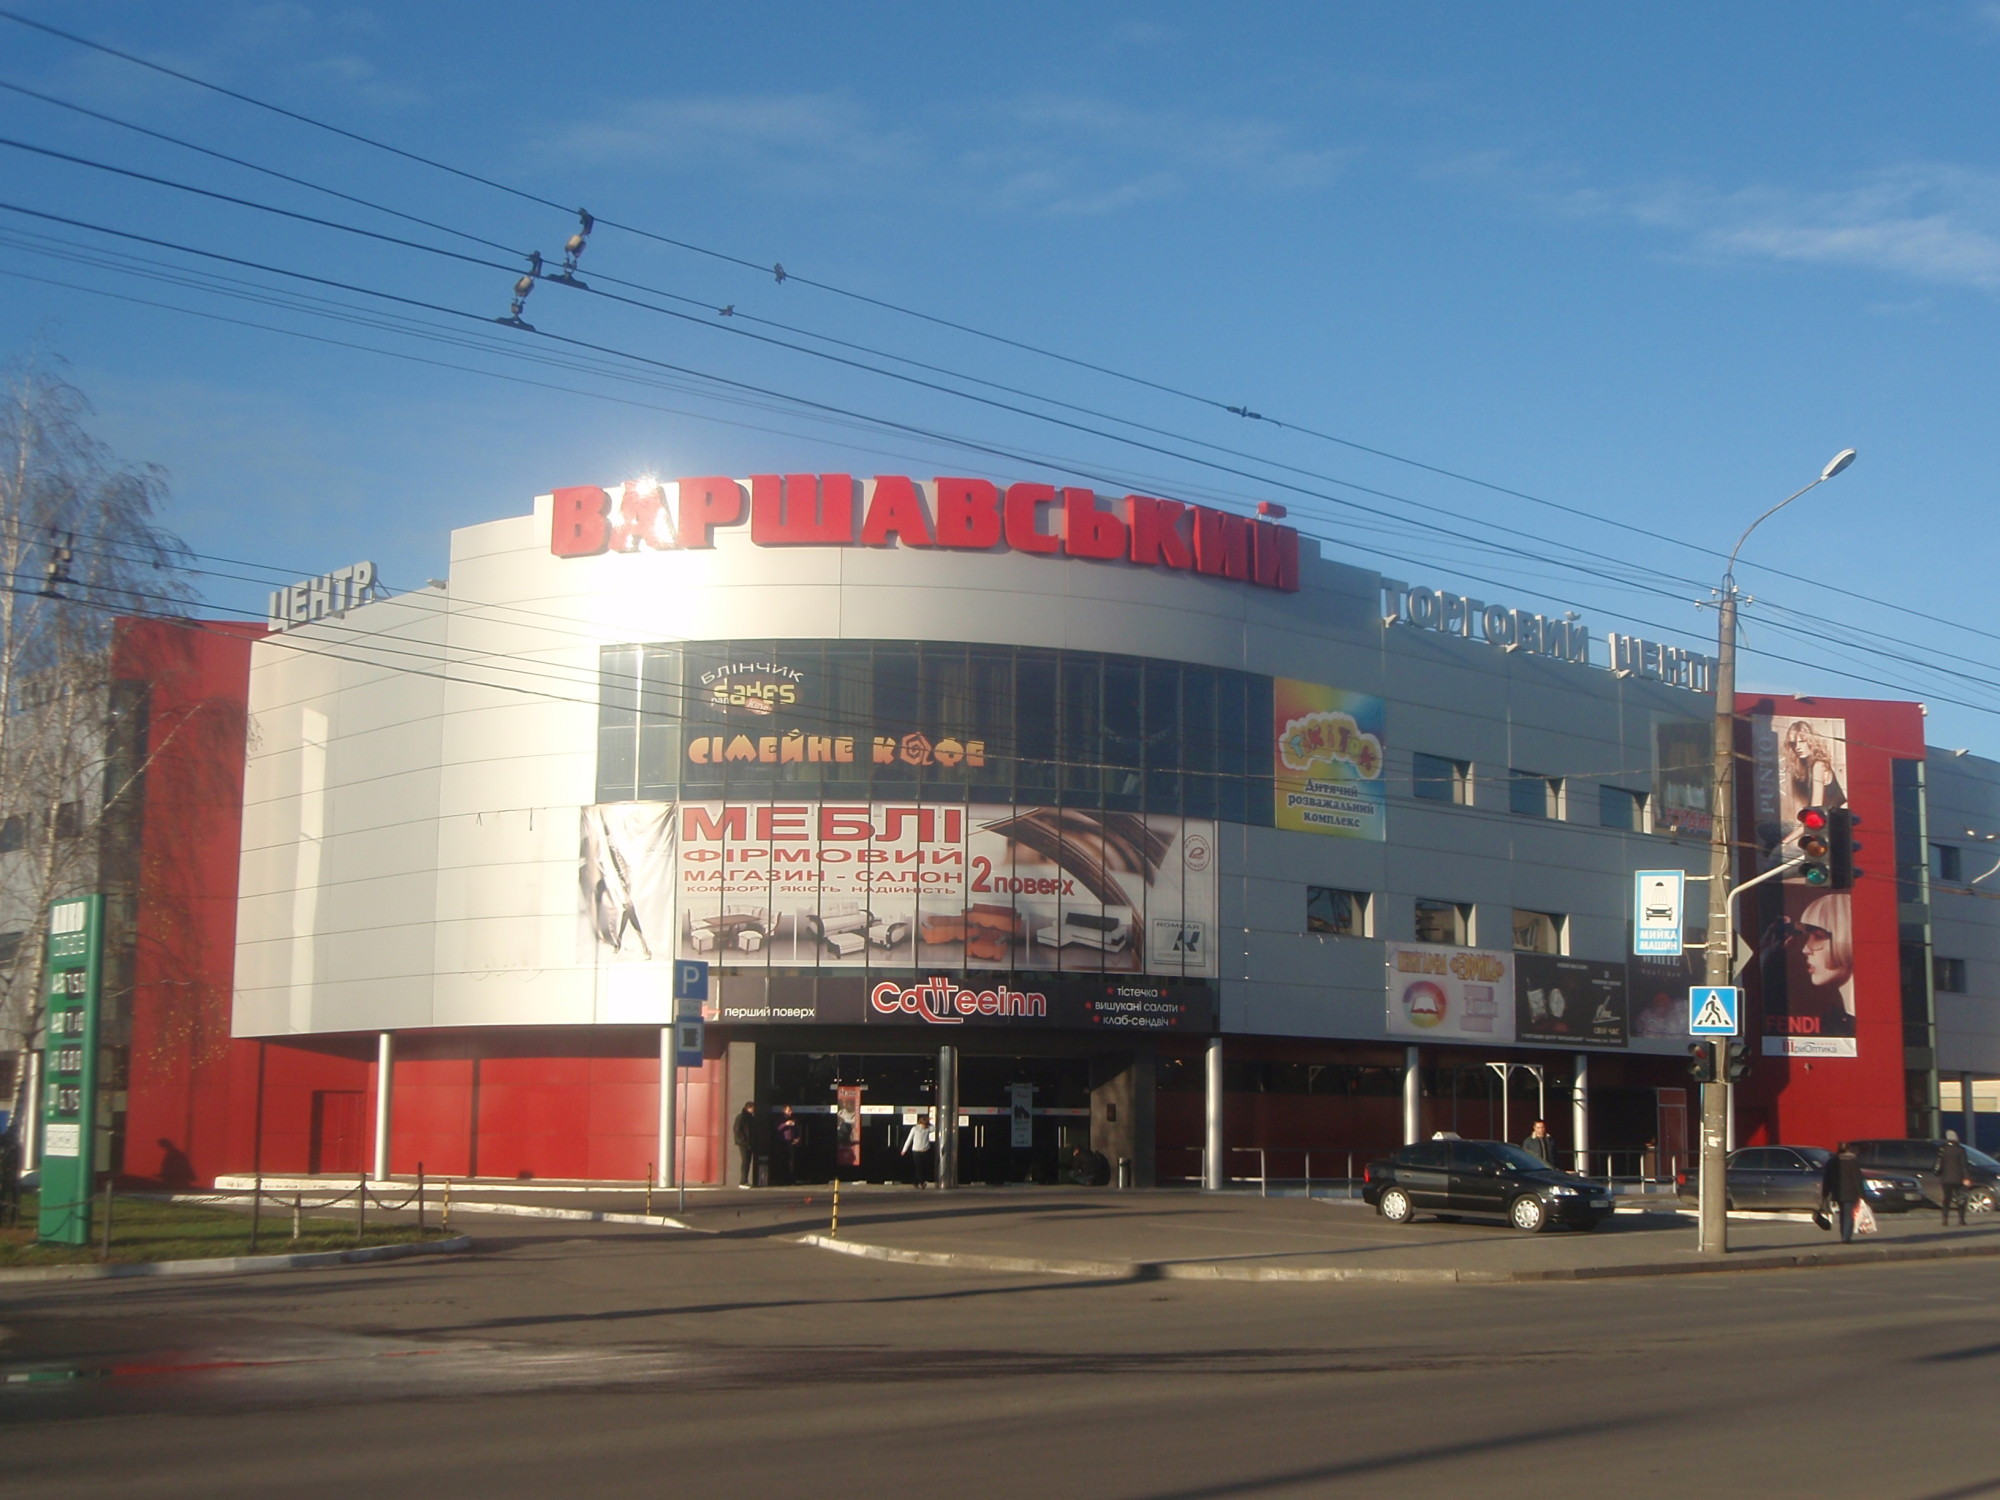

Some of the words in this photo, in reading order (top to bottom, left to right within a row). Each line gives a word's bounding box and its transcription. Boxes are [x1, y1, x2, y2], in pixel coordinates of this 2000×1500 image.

[551, 473, 1300, 592] ВАРШАВСЬКИЙ
[268, 560, 377, 632] ЦЕНТР
[1381, 576, 1590, 664] ТОРГОВИЙ
[700, 662, 804, 685] БЛІНЧИК
[688, 728, 854, 765] СІМЕЙНЕ
[1304, 778, 1359, 798] Дитячий
[1287, 794, 1375, 816] розважальний
[682, 806, 962, 844] МЕБЛІ
[1303, 811, 1361, 828] комплекс
[682, 847, 963, 865] ФІРМОВИЙ
[684, 869, 826, 882] МАГАЗИН
[854, 870, 962, 884] САЛОН
[970, 855, 992, 893] 2
[994, 874, 1075, 897] поверх
[780, 885, 841, 893] ЯКІСТЬ
[851, 887, 956, 895] НАДІЙНІСТЬ
[1640, 928, 1677, 940] МИЙКА
[1640, 940, 1677, 951] МАШИН
[682, 966, 700, 994] P
[1117, 986, 1159, 998] тістечка
[724, 1006, 771, 1019] перший
[772, 1007, 816, 1019] поверх
[1094, 1001, 1142, 1013] вишукані
[1143, 1002, 1179, 1013] салати
[1102, 1015, 1170, 1028] клаб-сендвіч
[1766, 1015, 1820, 1034] FENDI
